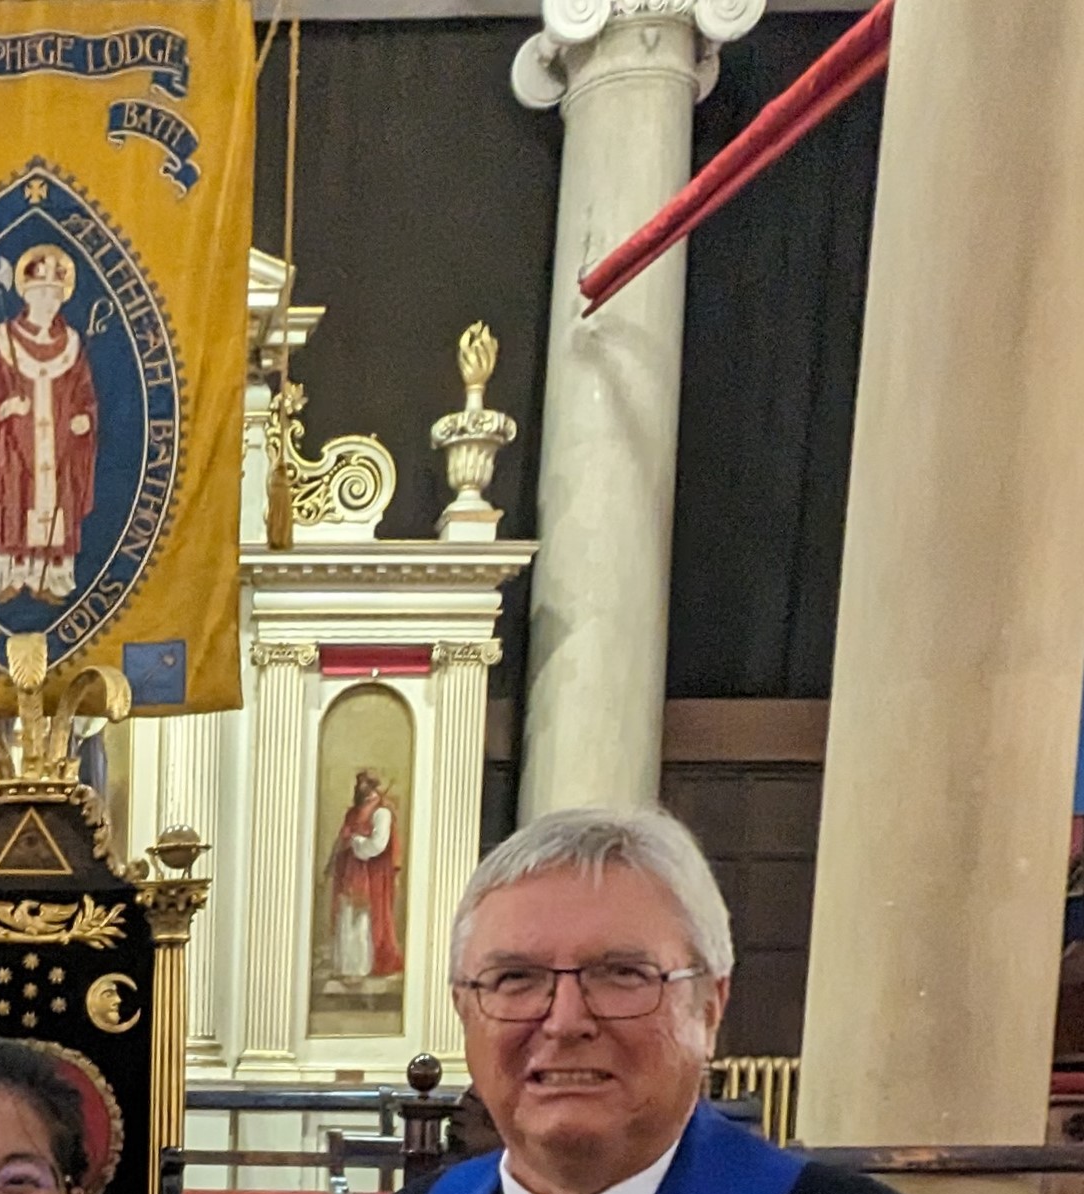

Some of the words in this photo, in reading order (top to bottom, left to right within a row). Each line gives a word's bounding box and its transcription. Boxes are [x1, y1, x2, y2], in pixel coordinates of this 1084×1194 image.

[87, 31, 182, 73] LODGE
[123, 103, 185, 148] BATH
[120, 418, 173, 562] BATHON
